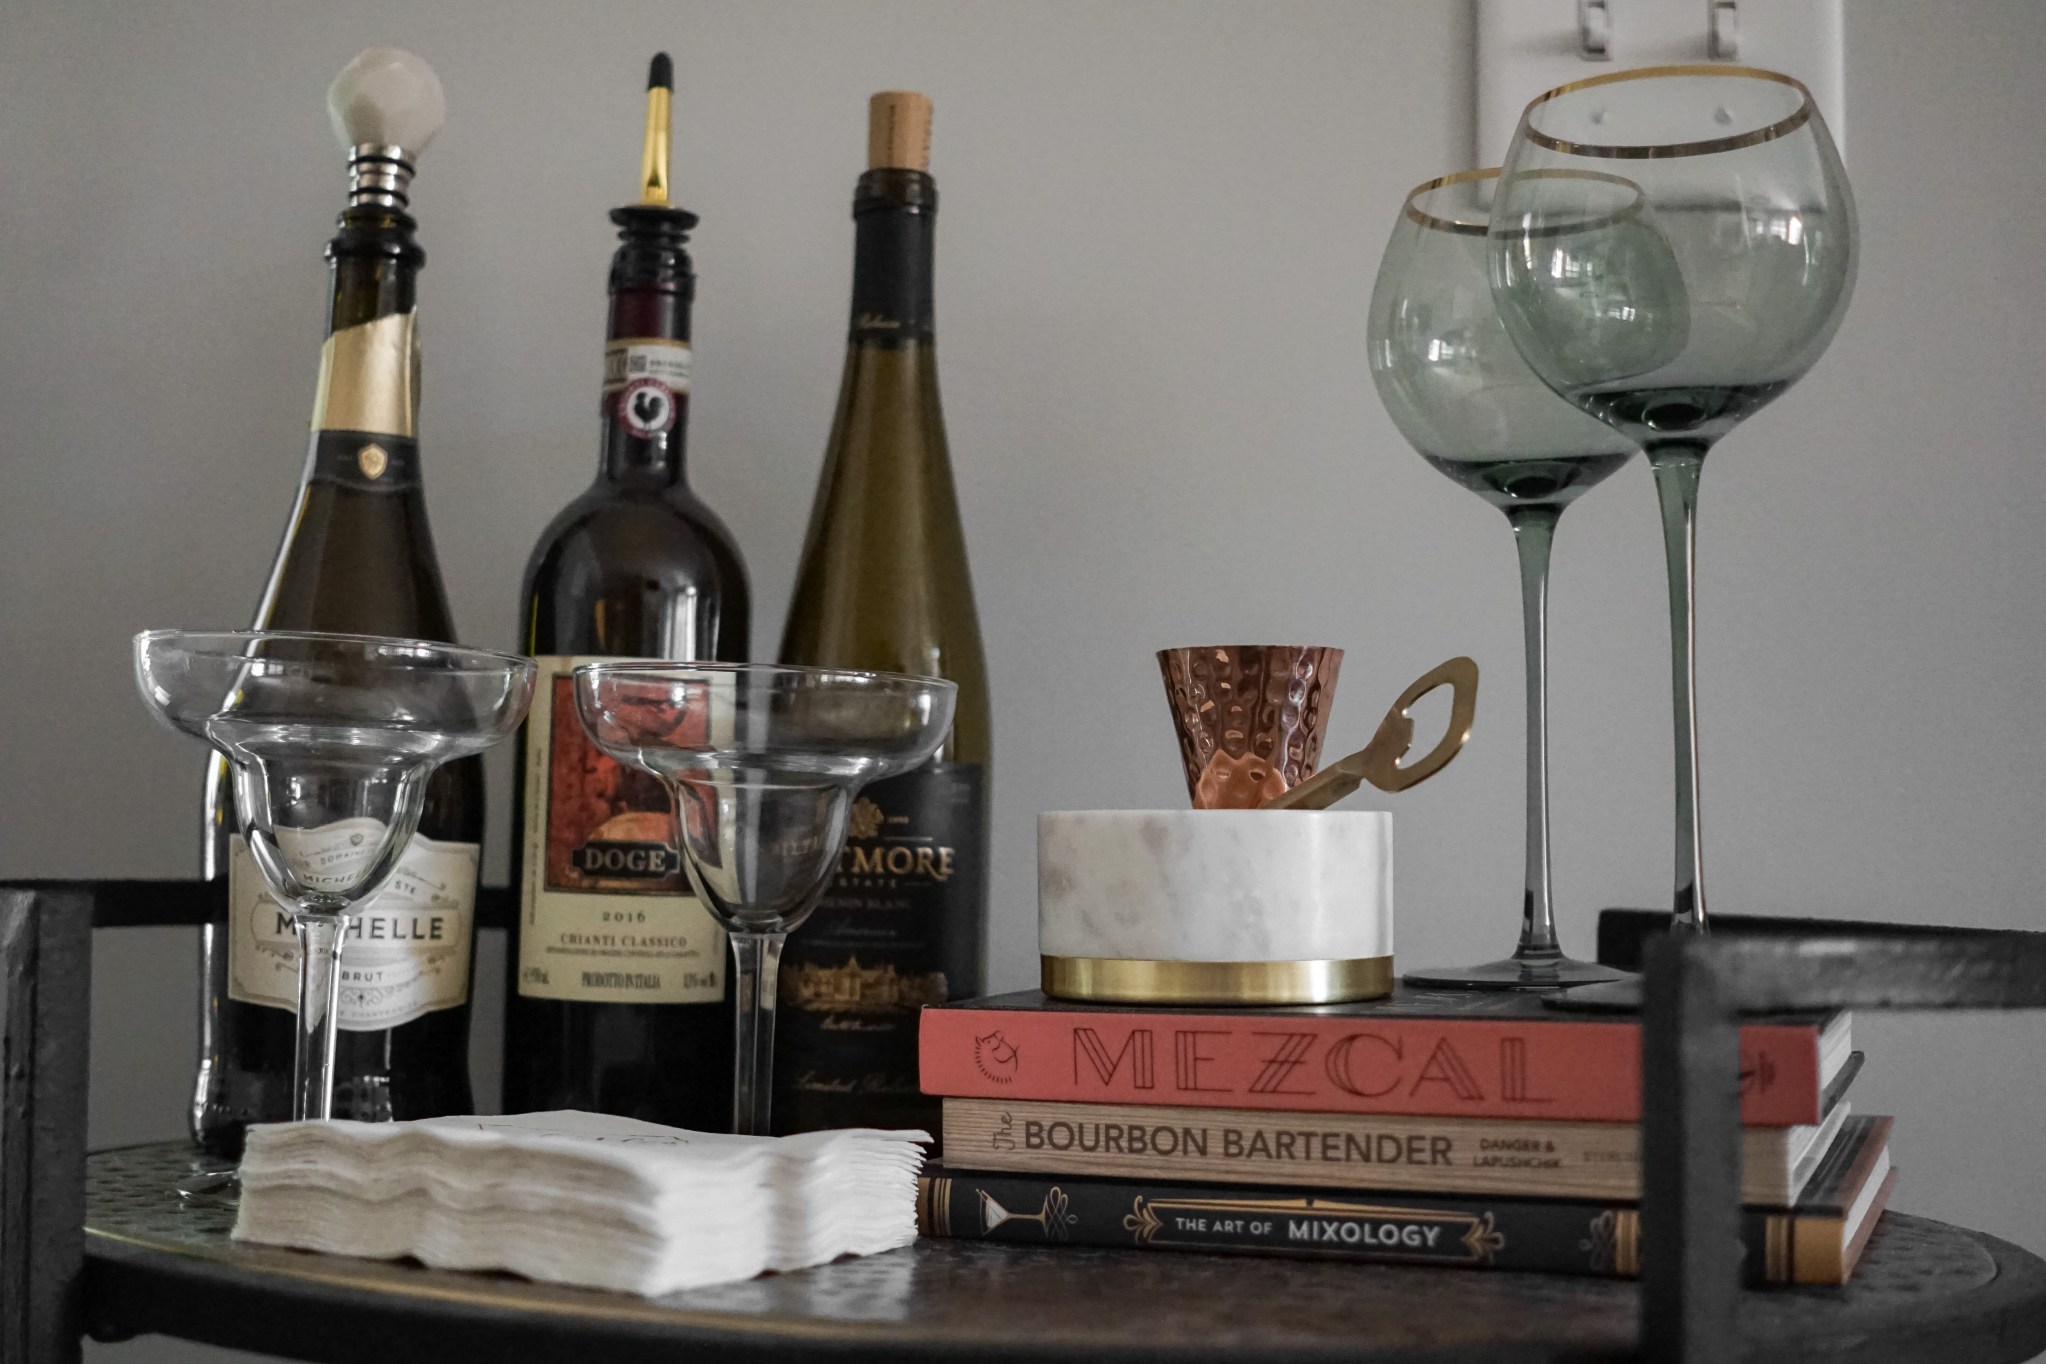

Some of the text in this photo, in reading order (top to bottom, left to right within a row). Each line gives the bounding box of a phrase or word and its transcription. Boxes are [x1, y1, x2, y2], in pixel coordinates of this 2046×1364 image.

[584, 849, 666, 873] DOGE
[276, 911, 444, 940] MHELLE
[602, 911, 646, 923] 2016
[560, 932, 688, 948] CHIANTI CLASSICO
[341, 971, 384, 982] BRUT
[1073, 1027, 1557, 1103] MEZCAL
[992, 1111, 1016, 1151] The
[1024, 1119, 1454, 1167] BOURBON BARTENDER
[1479, 1138, 1541, 1152] DANGER
[1176, 1217, 1442, 1247] THE ART OF MIXOLOGY
